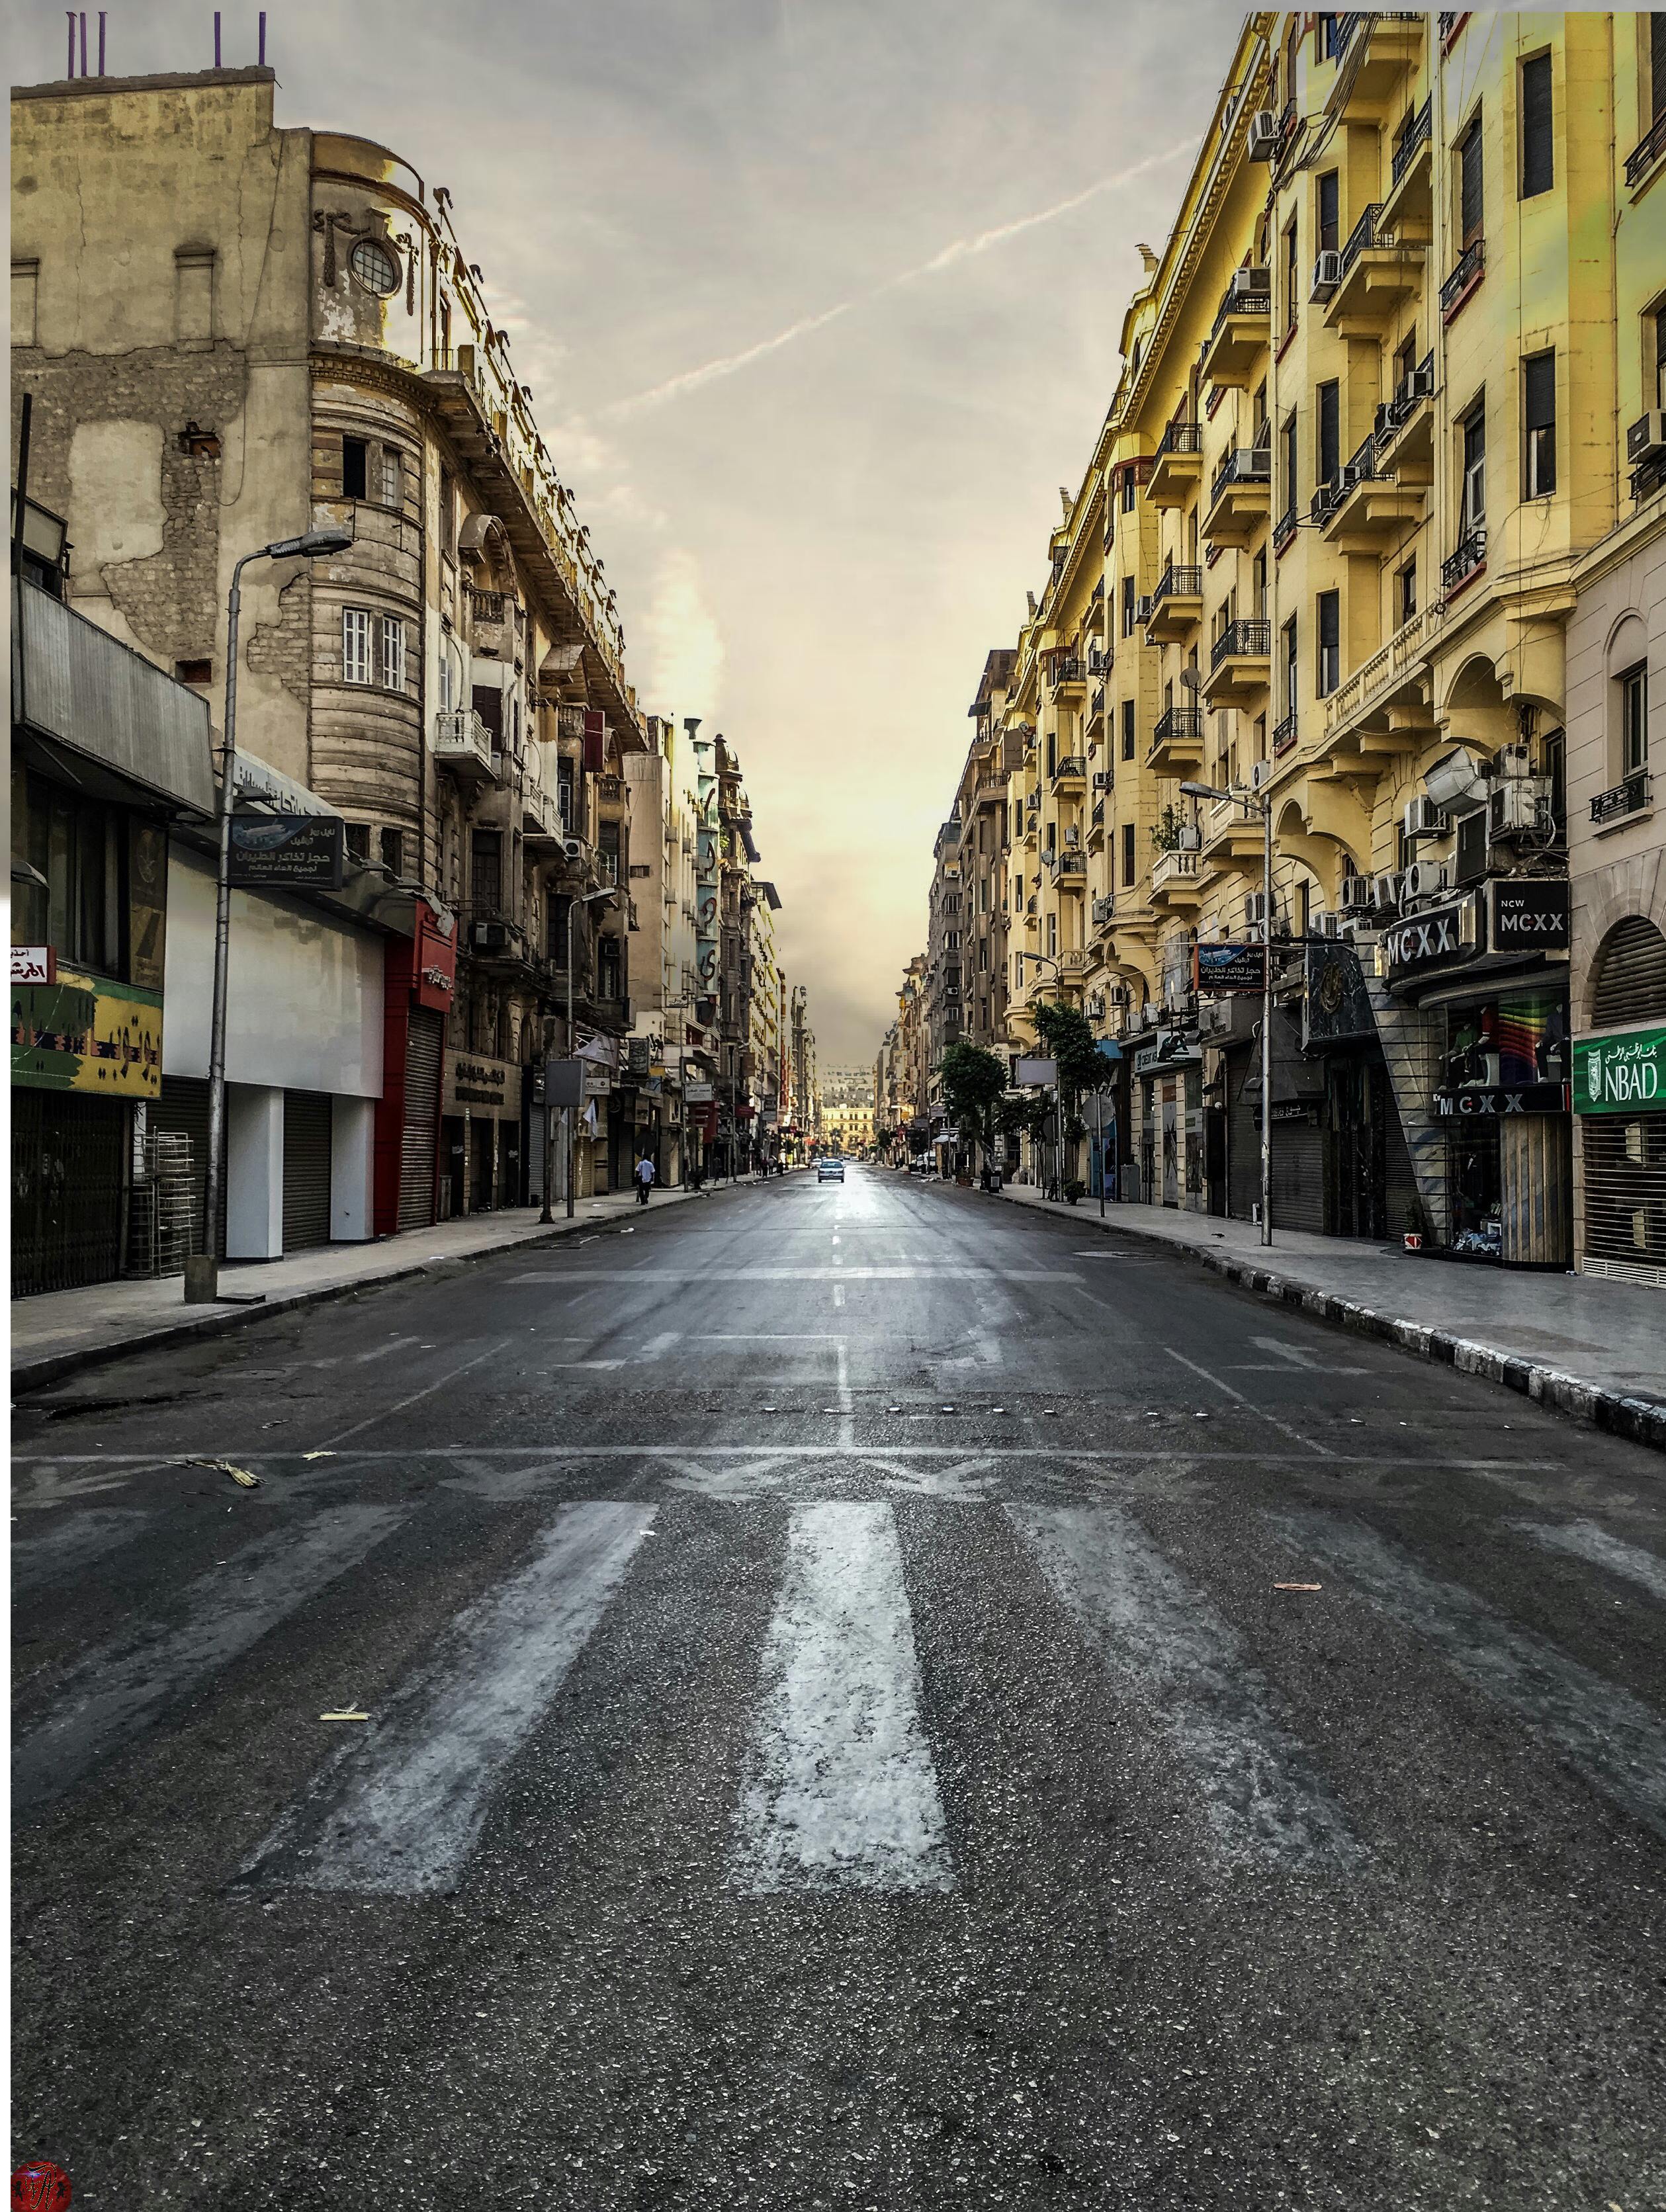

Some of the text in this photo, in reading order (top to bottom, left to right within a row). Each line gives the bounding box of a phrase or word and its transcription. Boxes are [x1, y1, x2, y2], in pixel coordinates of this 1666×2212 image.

[236, 851, 330, 864] حجز تذاكر الطيران
[11, 949, 29, 958] أحذي
[11, 962, 46, 980] المرش
[1604, 1062, 1657, 1101] NBAD
